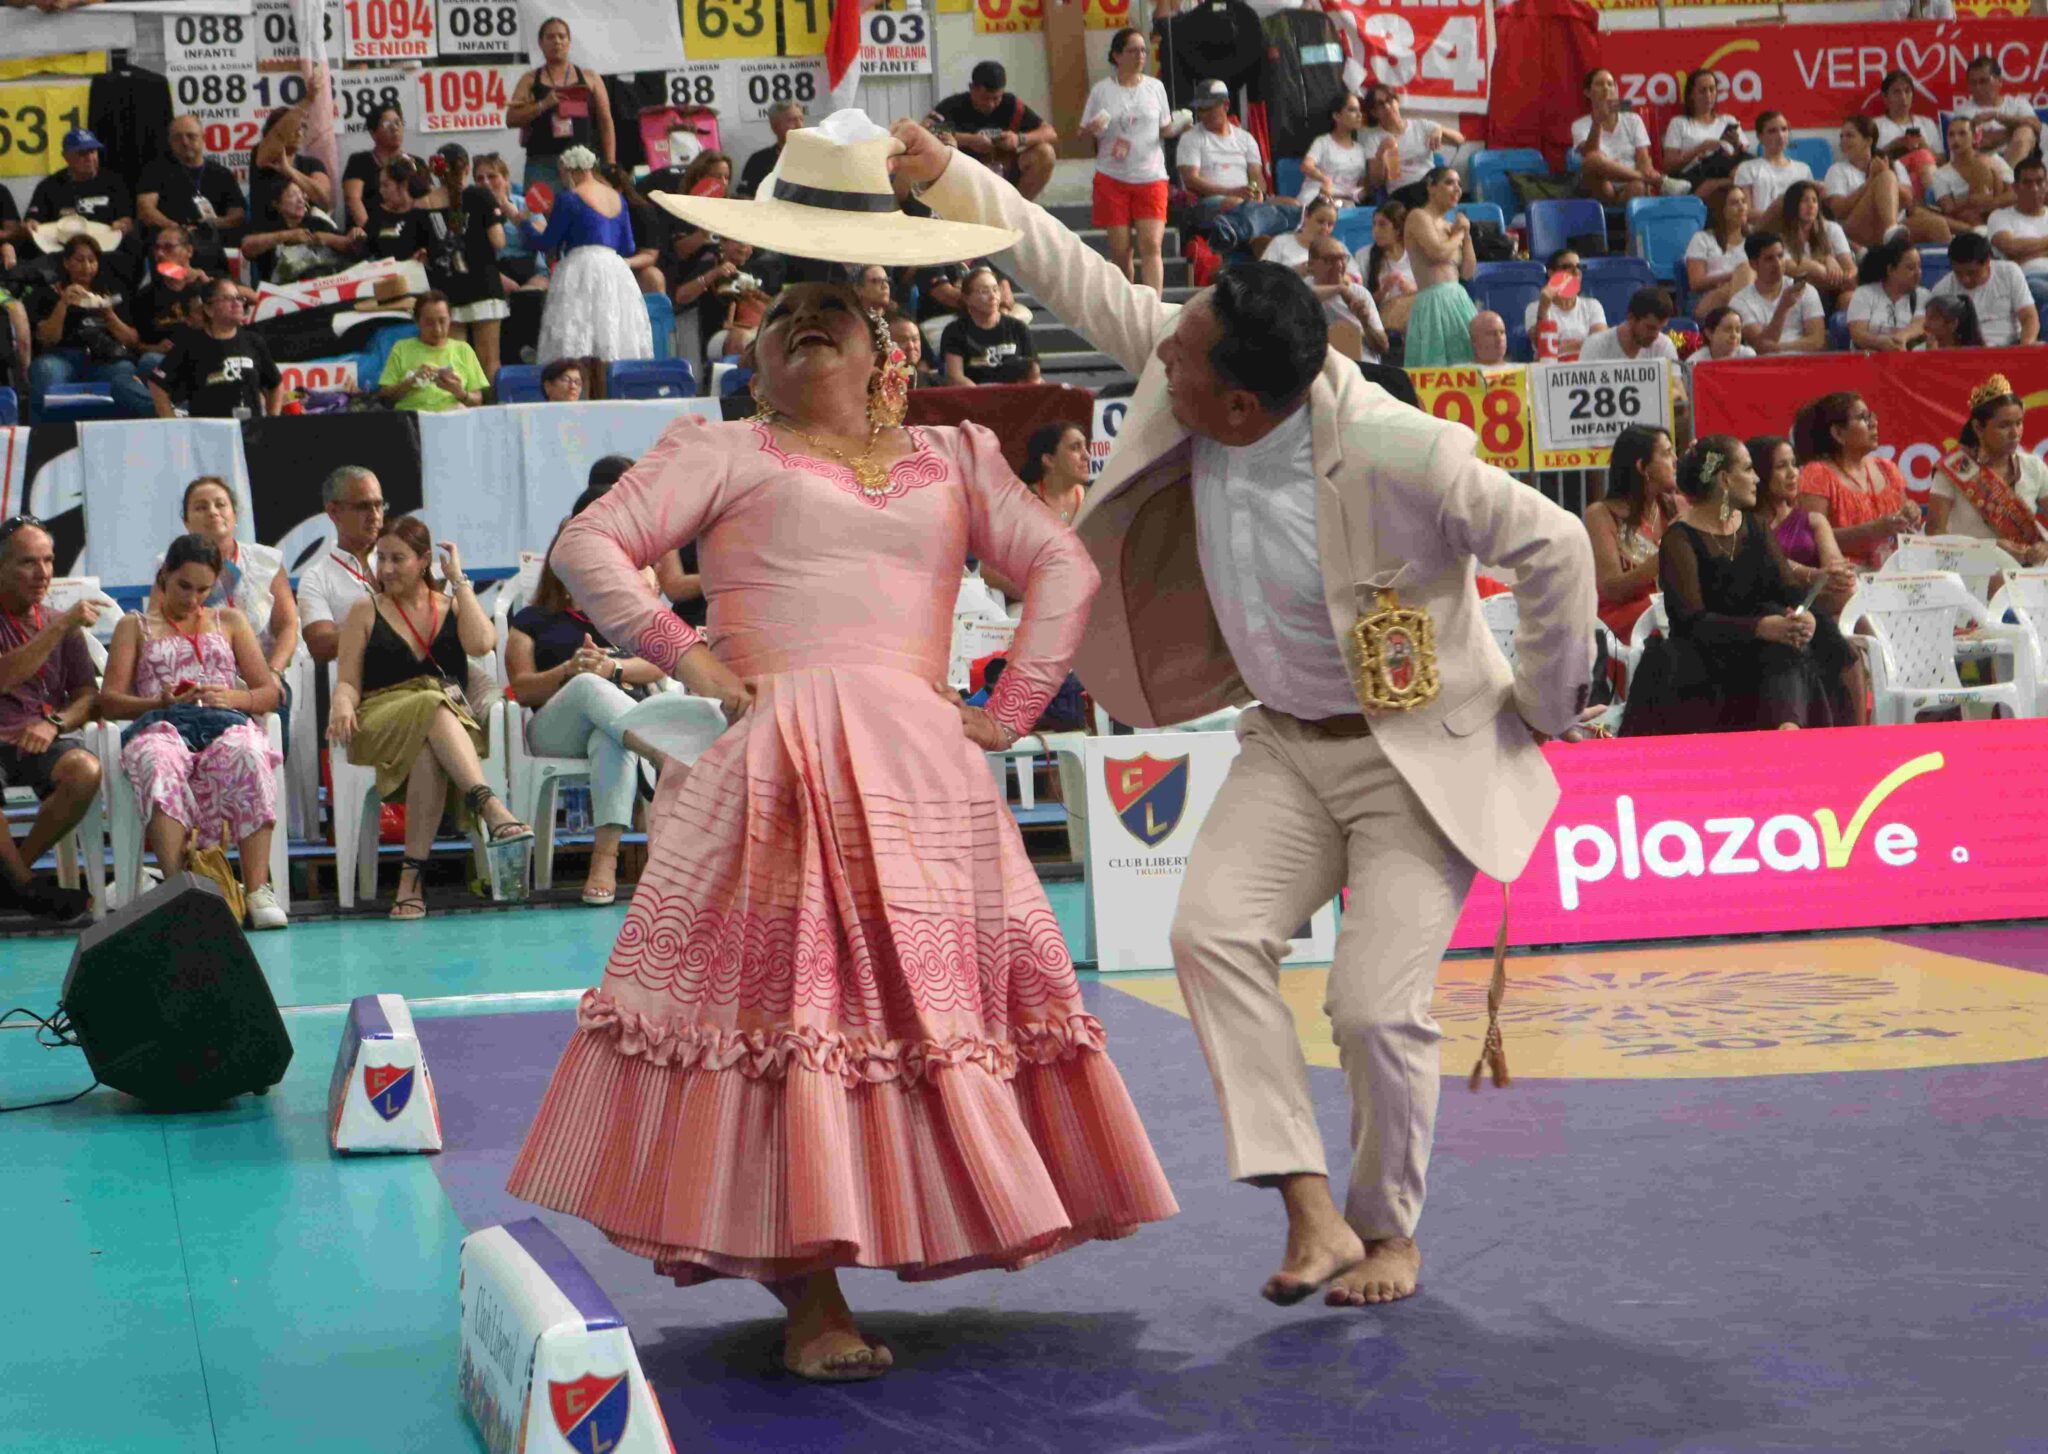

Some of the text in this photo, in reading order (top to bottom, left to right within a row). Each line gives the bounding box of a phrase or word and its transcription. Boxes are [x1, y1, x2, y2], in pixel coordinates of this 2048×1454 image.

[345, 0, 433, 41] 1094
[450, 7, 517, 37] 088
[175, 15, 244, 45] 088
[184, 48, 237, 60] INFANTE
[354, 40, 428, 57] SENIOR
[458, 41, 510, 51] INFANTE
[886, 45, 928, 59] MELANIA
[1364, 12, 1486, 92] 34
[170, 63, 208, 73] GOLDINA
[220, 63, 253, 71] ADRIAN
[688, 64, 720, 72] ADRIAN
[741, 64, 778, 72] GOLDINA
[789, 61, 821, 70] ADRIAN
[860, 61, 918, 72] NFANTE
[374, 73, 406, 84] ADRIAN
[178, 74, 247, 106] 088
[418, 69, 507, 114] 1094
[671, 75, 715, 106] 88
[749, 72, 816, 105] 088
[428, 113, 503, 130] SENIOR
[1552, 366, 1656, 387] AITANA & NALDO
[1568, 385, 1641, 420] 286
[1543, 451, 1599, 468] LEO Y
[1108, 856, 1189, 868] CLUB LIBERT
[1136, 867, 1182, 876] TRUJILLO
[1604, 1026, 1963, 1056] 2024
